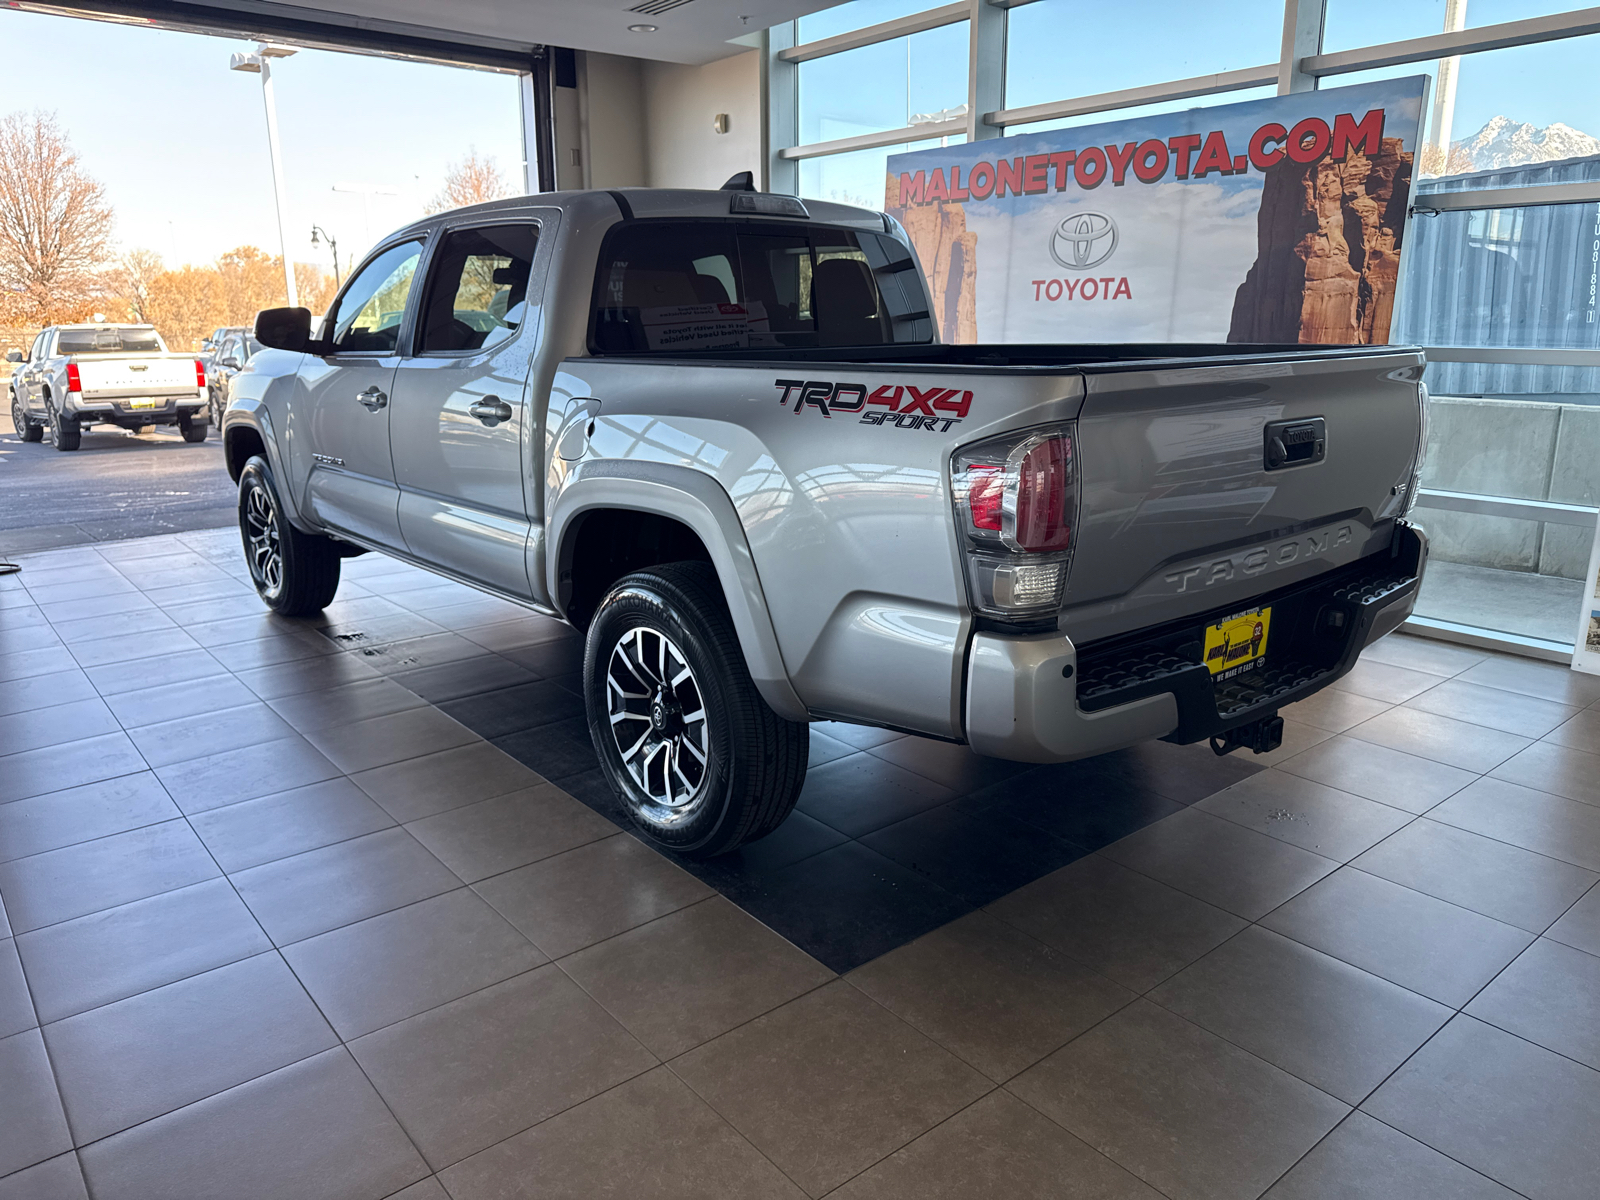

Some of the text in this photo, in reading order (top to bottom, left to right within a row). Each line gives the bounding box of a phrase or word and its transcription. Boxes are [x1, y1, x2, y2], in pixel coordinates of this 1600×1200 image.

[899, 108, 1385, 207] MALONETOYOTA.COM
[1031, 277, 1133, 301] TOYOTA
[774, 378, 869, 419] TRD
[858, 411, 963, 433] SPORT
[1288, 428, 1316, 443] TOYOTA
[1164, 525, 1353, 593] TACOMA
[1255, 626, 1262, 635] 32
[1217, 673, 1224, 682] WE
[1225, 669, 1238, 680] MAKE
[1243, 662, 1255, 673] EASY
